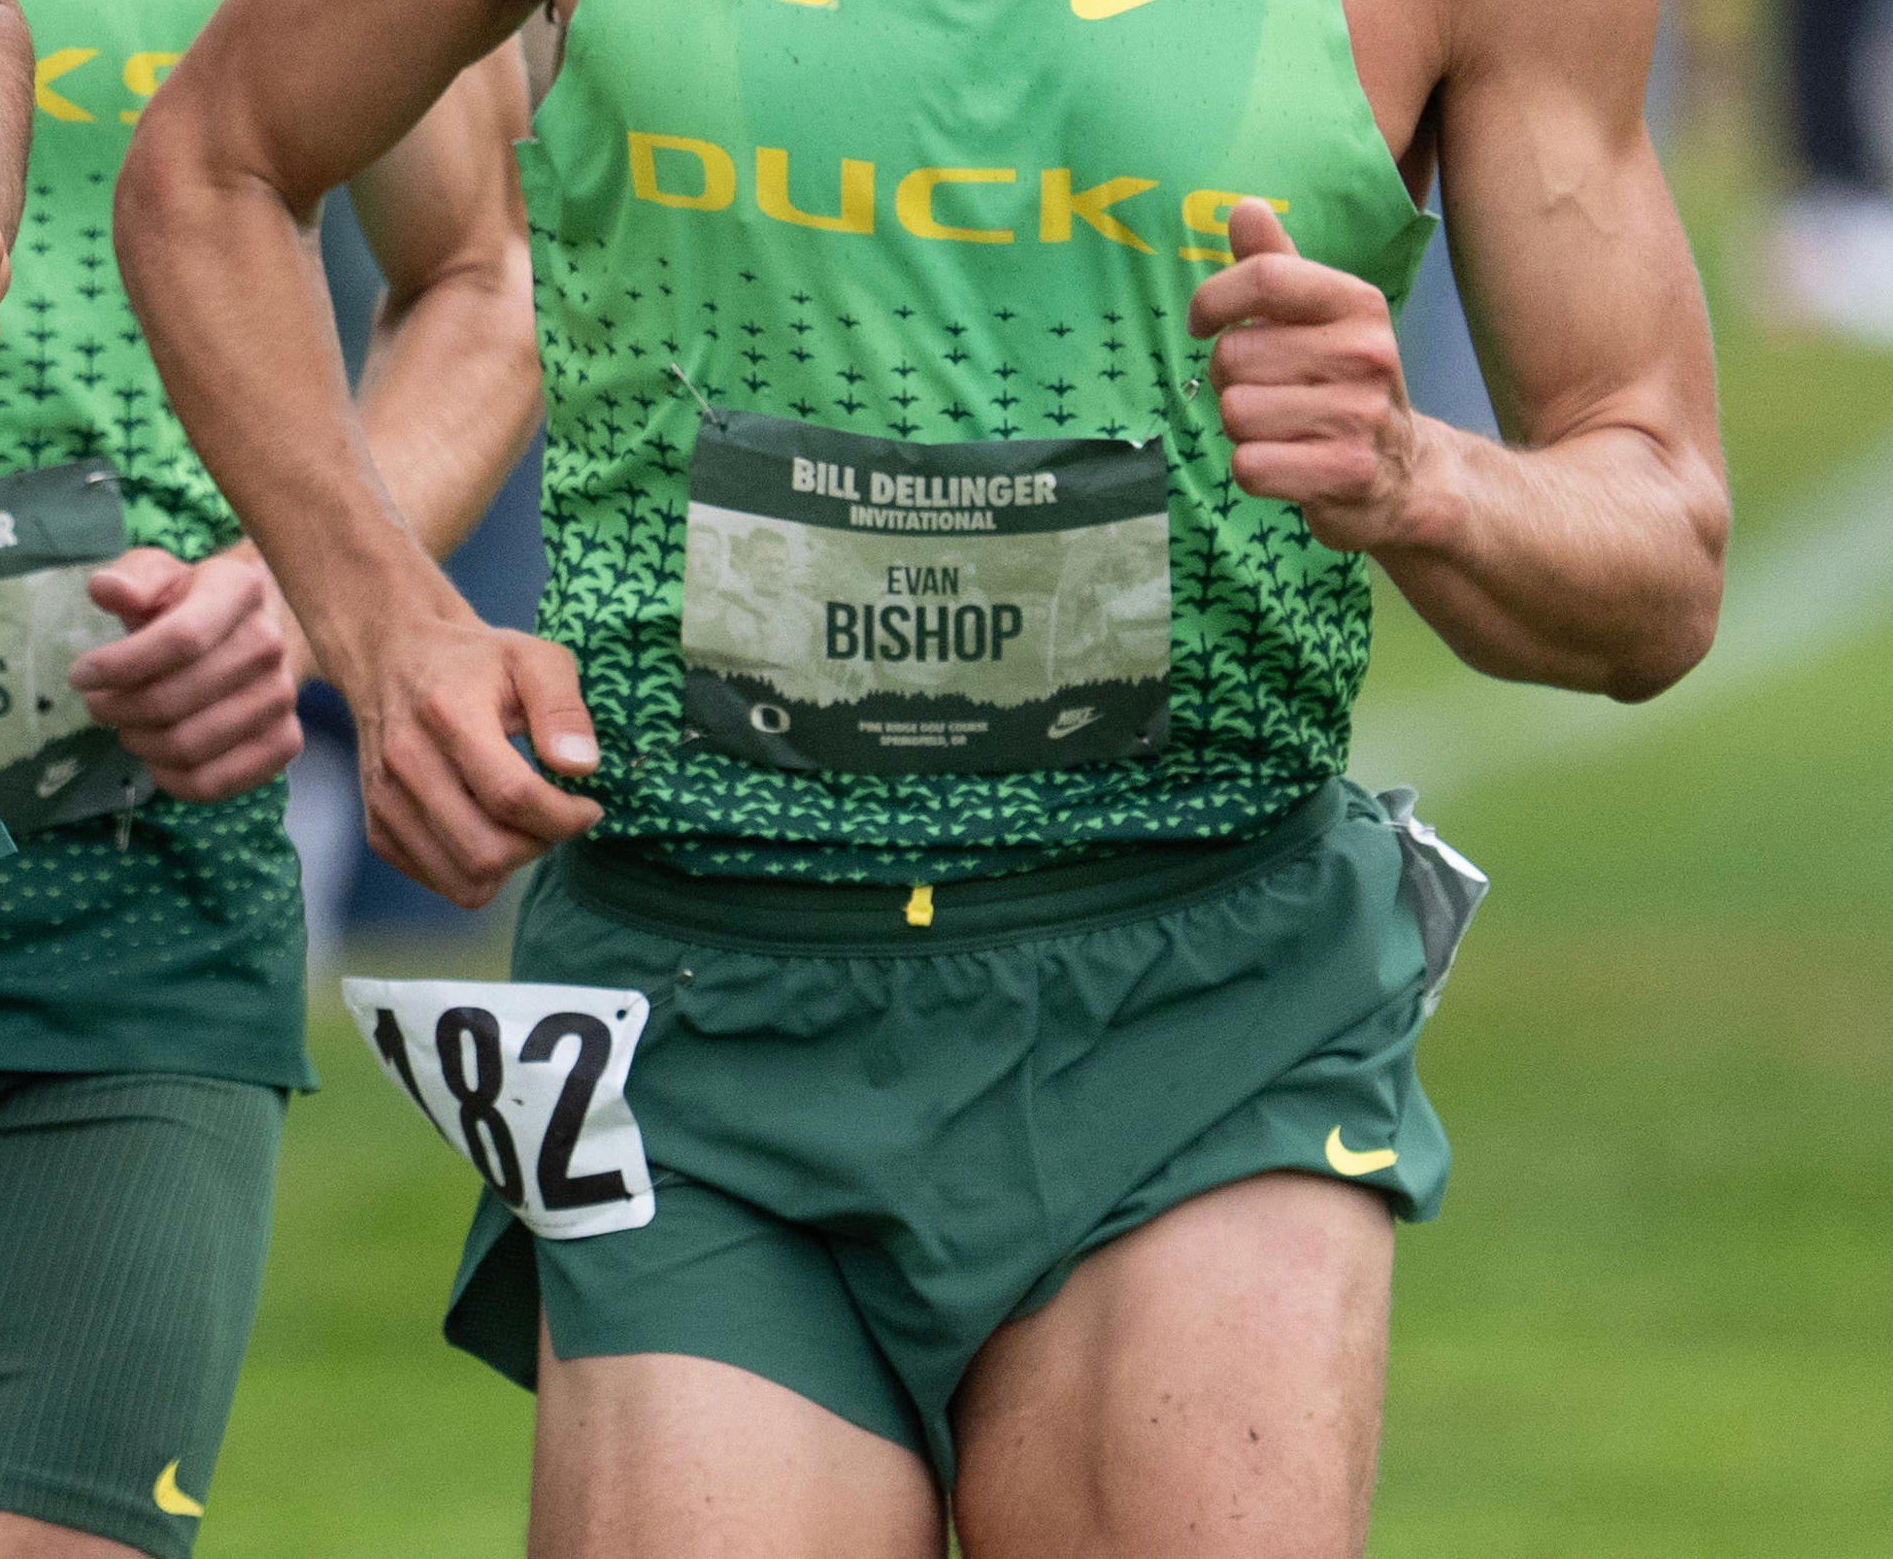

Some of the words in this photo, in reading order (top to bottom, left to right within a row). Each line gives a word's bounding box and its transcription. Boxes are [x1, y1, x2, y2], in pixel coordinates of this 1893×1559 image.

[627, 130, 1290, 265] DUCKS
[792, 457, 860, 500] BILL
[870, 472, 1058, 507] DELLINGER
[850, 505, 997, 531] INVITATIONAL
[887, 566, 960, 596] EVAN
[826, 601, 1023, 662] BISHOP
[374, 1006, 632, 1211] 182
